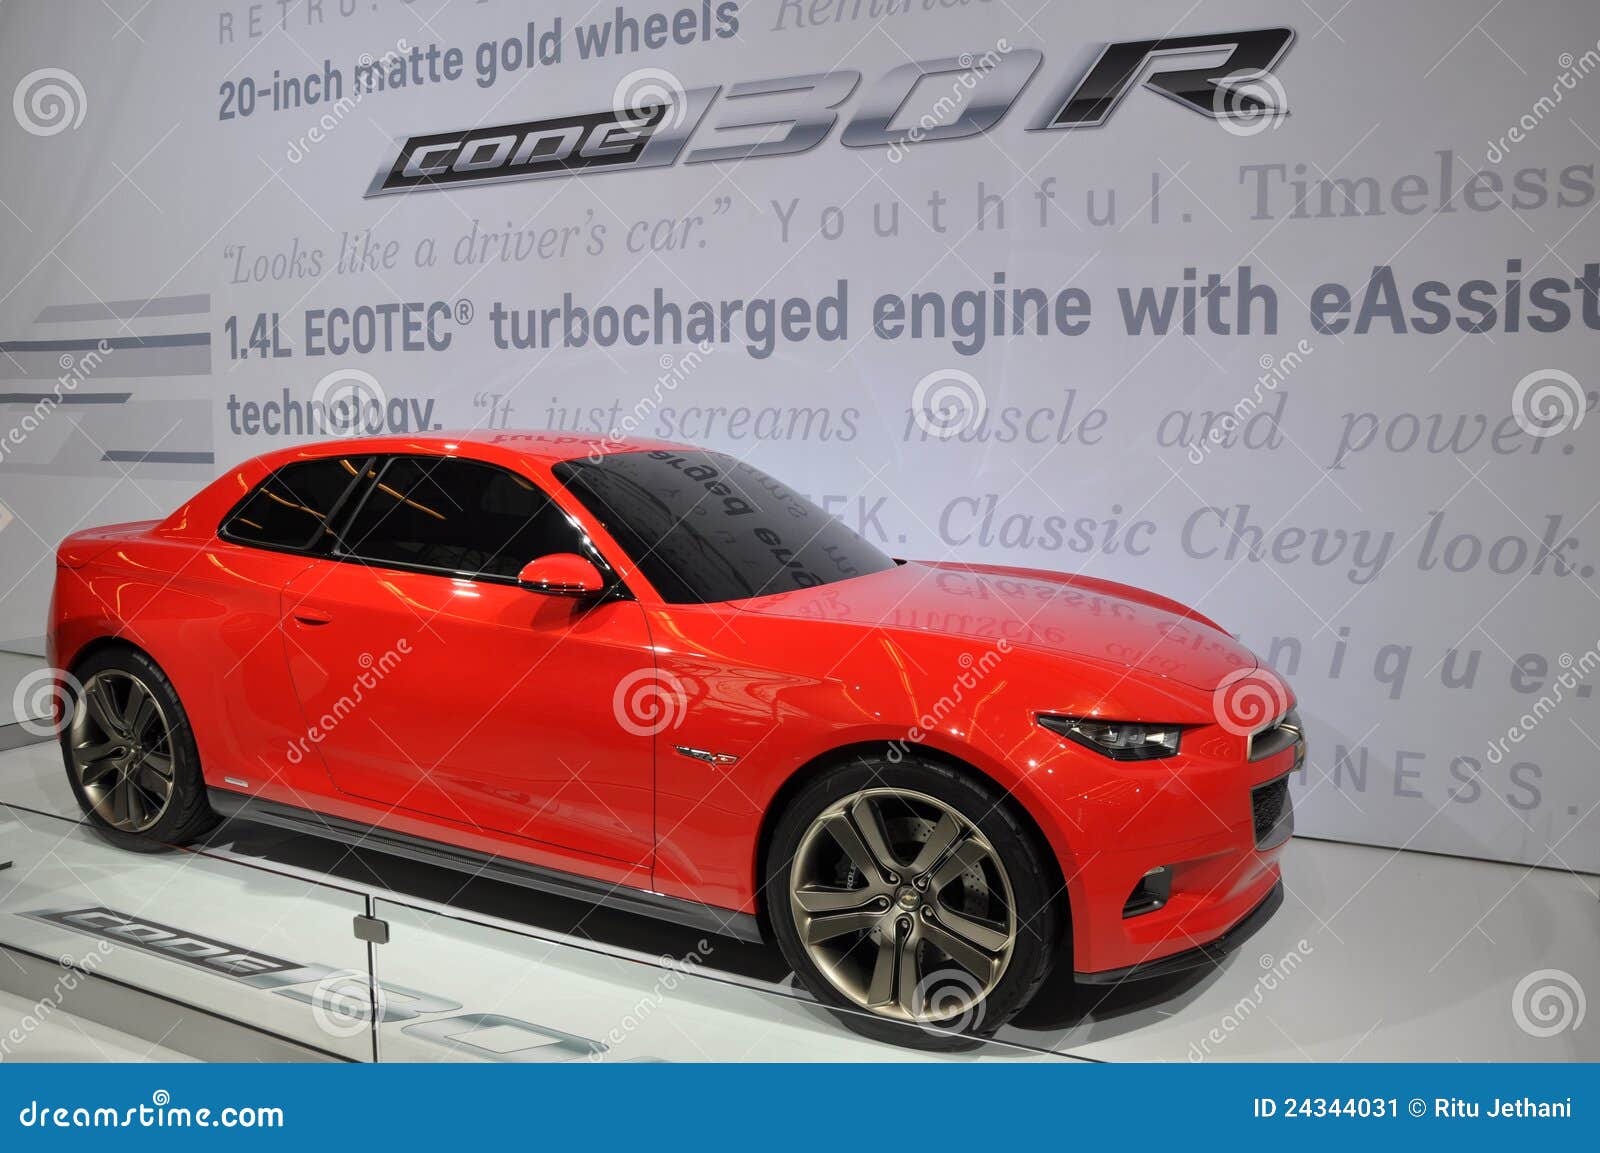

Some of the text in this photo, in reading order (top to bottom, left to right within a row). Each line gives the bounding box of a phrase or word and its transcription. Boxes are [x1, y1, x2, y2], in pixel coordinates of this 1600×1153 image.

[218, 59, 343, 121] 20-inch
[354, 43, 463, 97] matte
[475, 16, 562, 89] gold
[574, 0, 740, 60] wheels
[400, 117, 656, 178] CODE
[222, 243, 323, 284] “Looks
[336, 230, 401, 276] like
[413, 237, 437, 268] a
[769, 171, 1194, 243] Youthful.
[1238, 149, 1596, 222] Timeless
[224, 312, 292, 360] 1.4L
[490, 279, 849, 360] turbocharged
[872, 271, 1092, 356] engine
[1116, 266, 1279, 336] with
[1309, 258, 1600, 335] eAssist
[654, 405, 862, 442] screams
[902, 388, 1109, 446] muscle
[1156, 391, 1289, 451] and
[937, 493, 1158, 556] Classic
[1180, 503, 1396, 585] Chevy
[1416, 510, 1596, 579] look.
[1234, 626, 1593, 701] nique.
